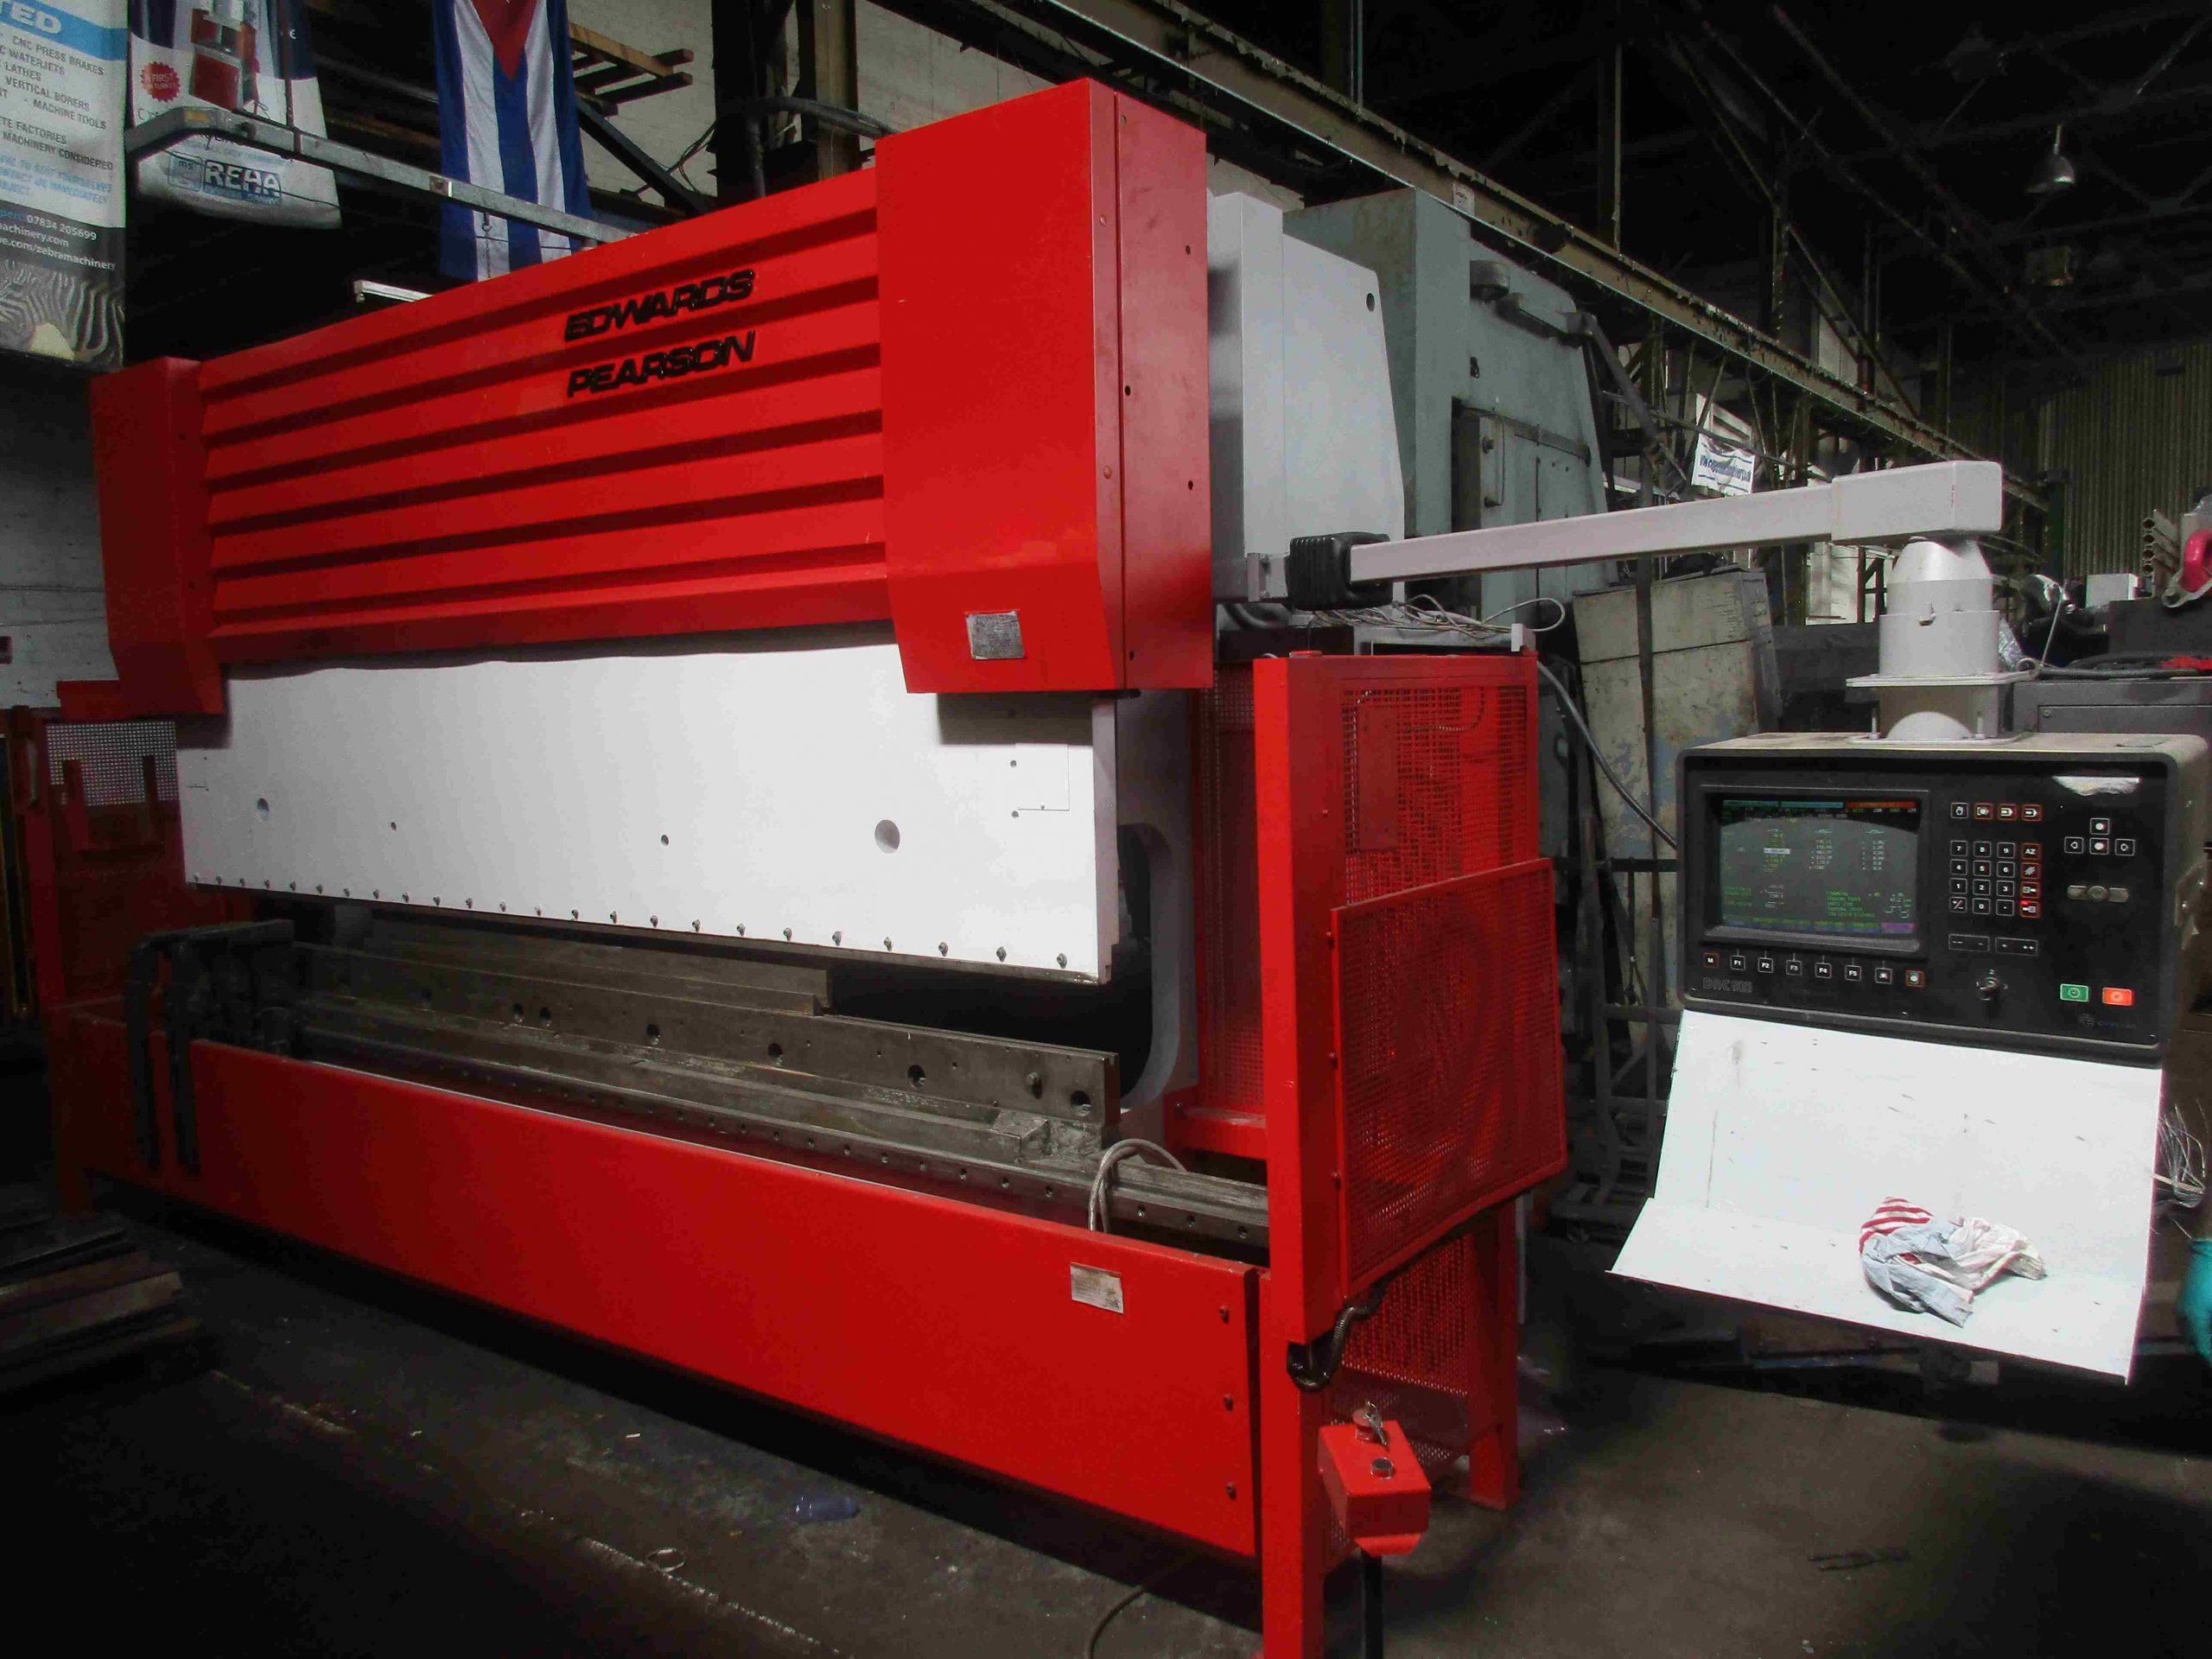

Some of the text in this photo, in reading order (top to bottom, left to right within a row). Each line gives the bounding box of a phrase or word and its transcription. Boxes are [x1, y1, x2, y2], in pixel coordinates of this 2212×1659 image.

[5, 61, 41, 81] LATHES
[10, 48, 66, 76] WATERJETS
[13, 35, 105, 76] CNC PRESS BRAKES
[6, 77, 90, 112] VERTICAL BORERS
[33, 99, 76, 120] MACHINE
[78, 113, 108, 130] TOOLS
[16, 121, 67, 145] FACTORIES
[3, 130, 57, 156] MACHINERY
[58, 148, 113, 171] CONSIDERED
[0, 222, 69, 248] achinery.com
[27, 215, 58, 231] 07834
[60, 224, 98, 241] 205699
[0, 237, 117, 270] e.com/zebramachinery
[564, 269, 755, 342] EDWARDS
[566, 329, 756, 397] PEARSON
